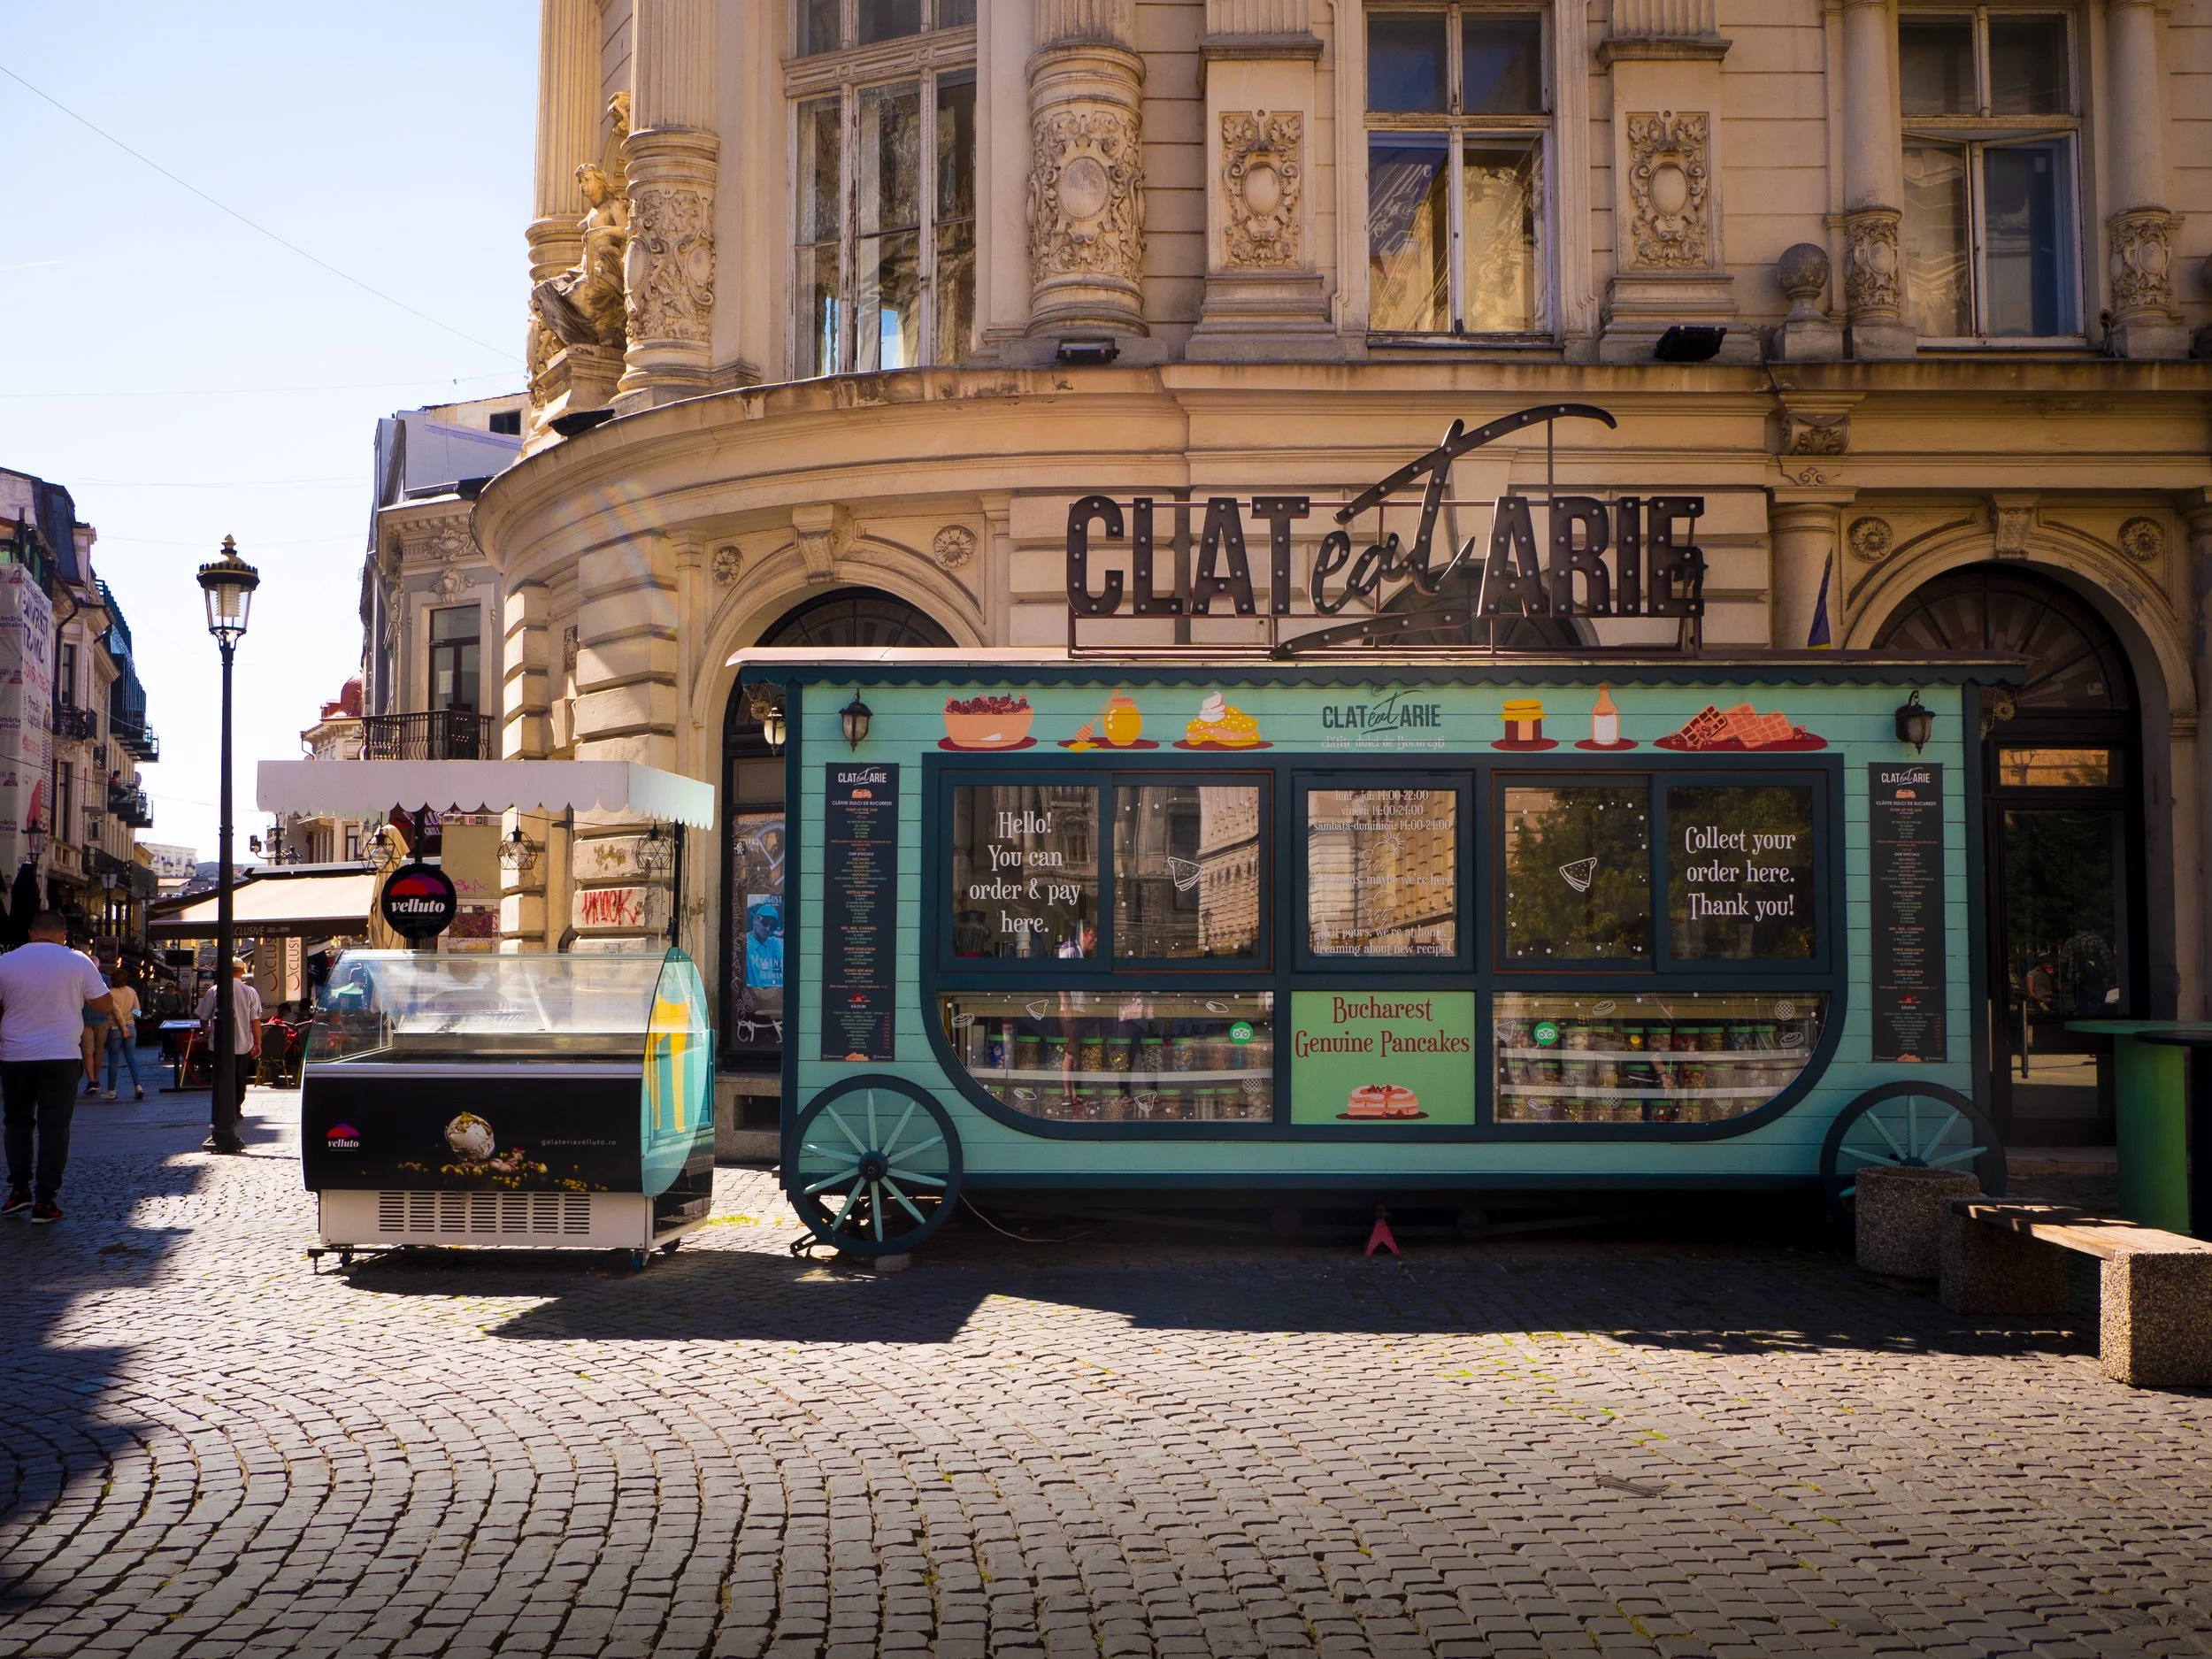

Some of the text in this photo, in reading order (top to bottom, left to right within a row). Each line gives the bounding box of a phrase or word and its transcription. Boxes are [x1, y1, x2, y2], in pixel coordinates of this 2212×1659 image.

[1382, 736, 1394, 748] de
[998, 810, 1052, 839] Hello!
[1685, 826, 1796, 856] Collect your
[987, 844, 1063, 872] You can
[1686, 859, 1795, 883] order here.
[969, 877, 1081, 906] order & pay
[390, 898, 446, 913] velluto
[1687, 893, 1794, 922] Thank you!
[1001, 910, 1049, 933] here.
[1313, 941, 1361, 956] dreaming
[1363, 941, 1392, 955] about
[1394, 943, 1414, 954] new
[1333, 995, 1433, 1024] Bucharest
[1294, 1030, 1471, 1058] Genuine Pancakes
[328, 1138, 359, 1148] velluto
[541, 1138, 617, 1147] gelateriavelluto.ro
